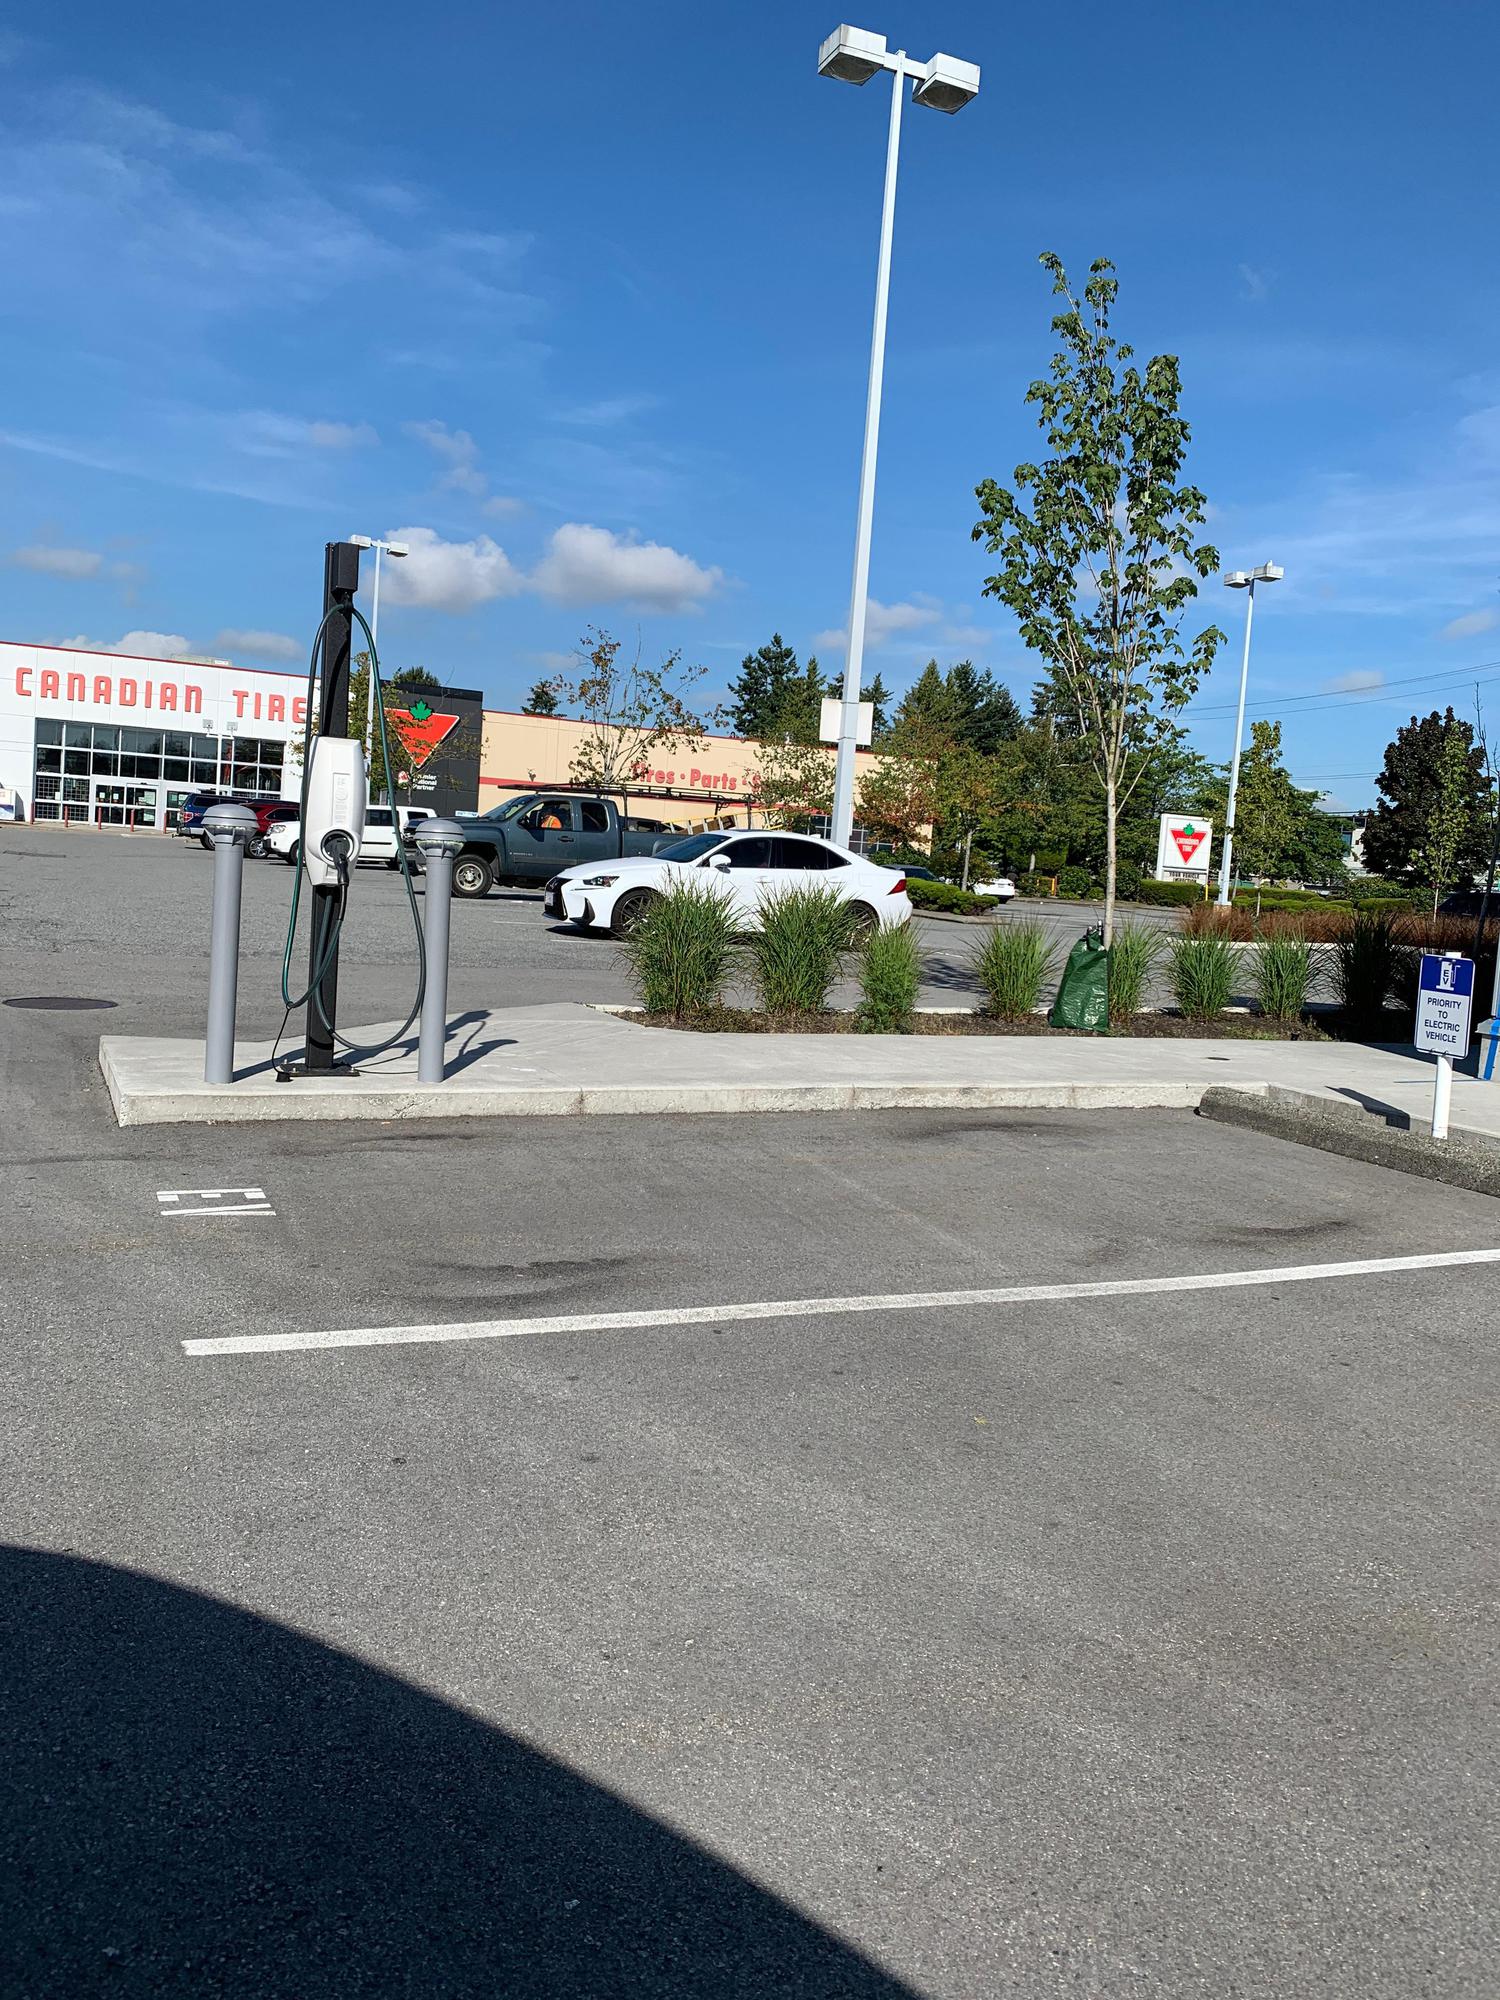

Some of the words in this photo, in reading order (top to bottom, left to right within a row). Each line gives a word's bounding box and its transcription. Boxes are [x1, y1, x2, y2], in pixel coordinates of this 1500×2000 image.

[15, 667, 203, 714] CANADIAN
[232, 690, 307, 724] TIRE
[690, 768, 738, 791] Parts
[1443, 970, 1449, 985] EV
[1427, 997, 1461, 1009] PRIORITY
[1438, 1010, 1448, 1019] TO
[1424, 1019, 1460, 1032] ELECTRIC
[1425, 1031, 1456, 1043] VEHICLE
